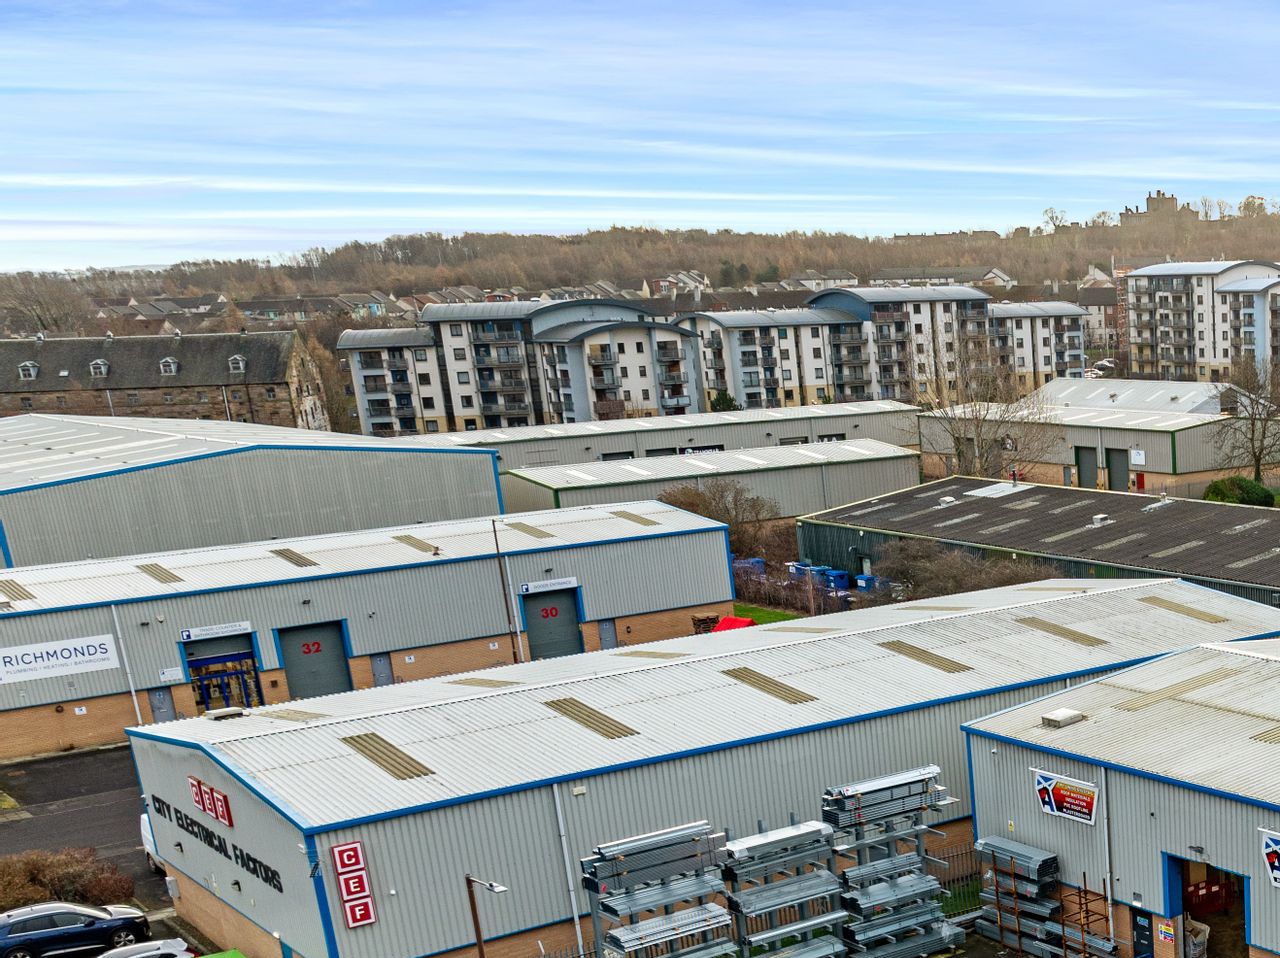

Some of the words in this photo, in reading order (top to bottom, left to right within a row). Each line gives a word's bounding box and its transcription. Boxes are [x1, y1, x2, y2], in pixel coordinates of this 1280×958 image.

[541, 607, 558, 618] 30
[302, 642, 322, 655] 32
[3, 643, 109, 668] RICHMONDS
[74, 657, 111, 666] BATHROOMS
[151, 794, 173, 822] CITY
[174, 807, 233, 861] ELECTRICAL
[231, 843, 284, 893] FACTORS
